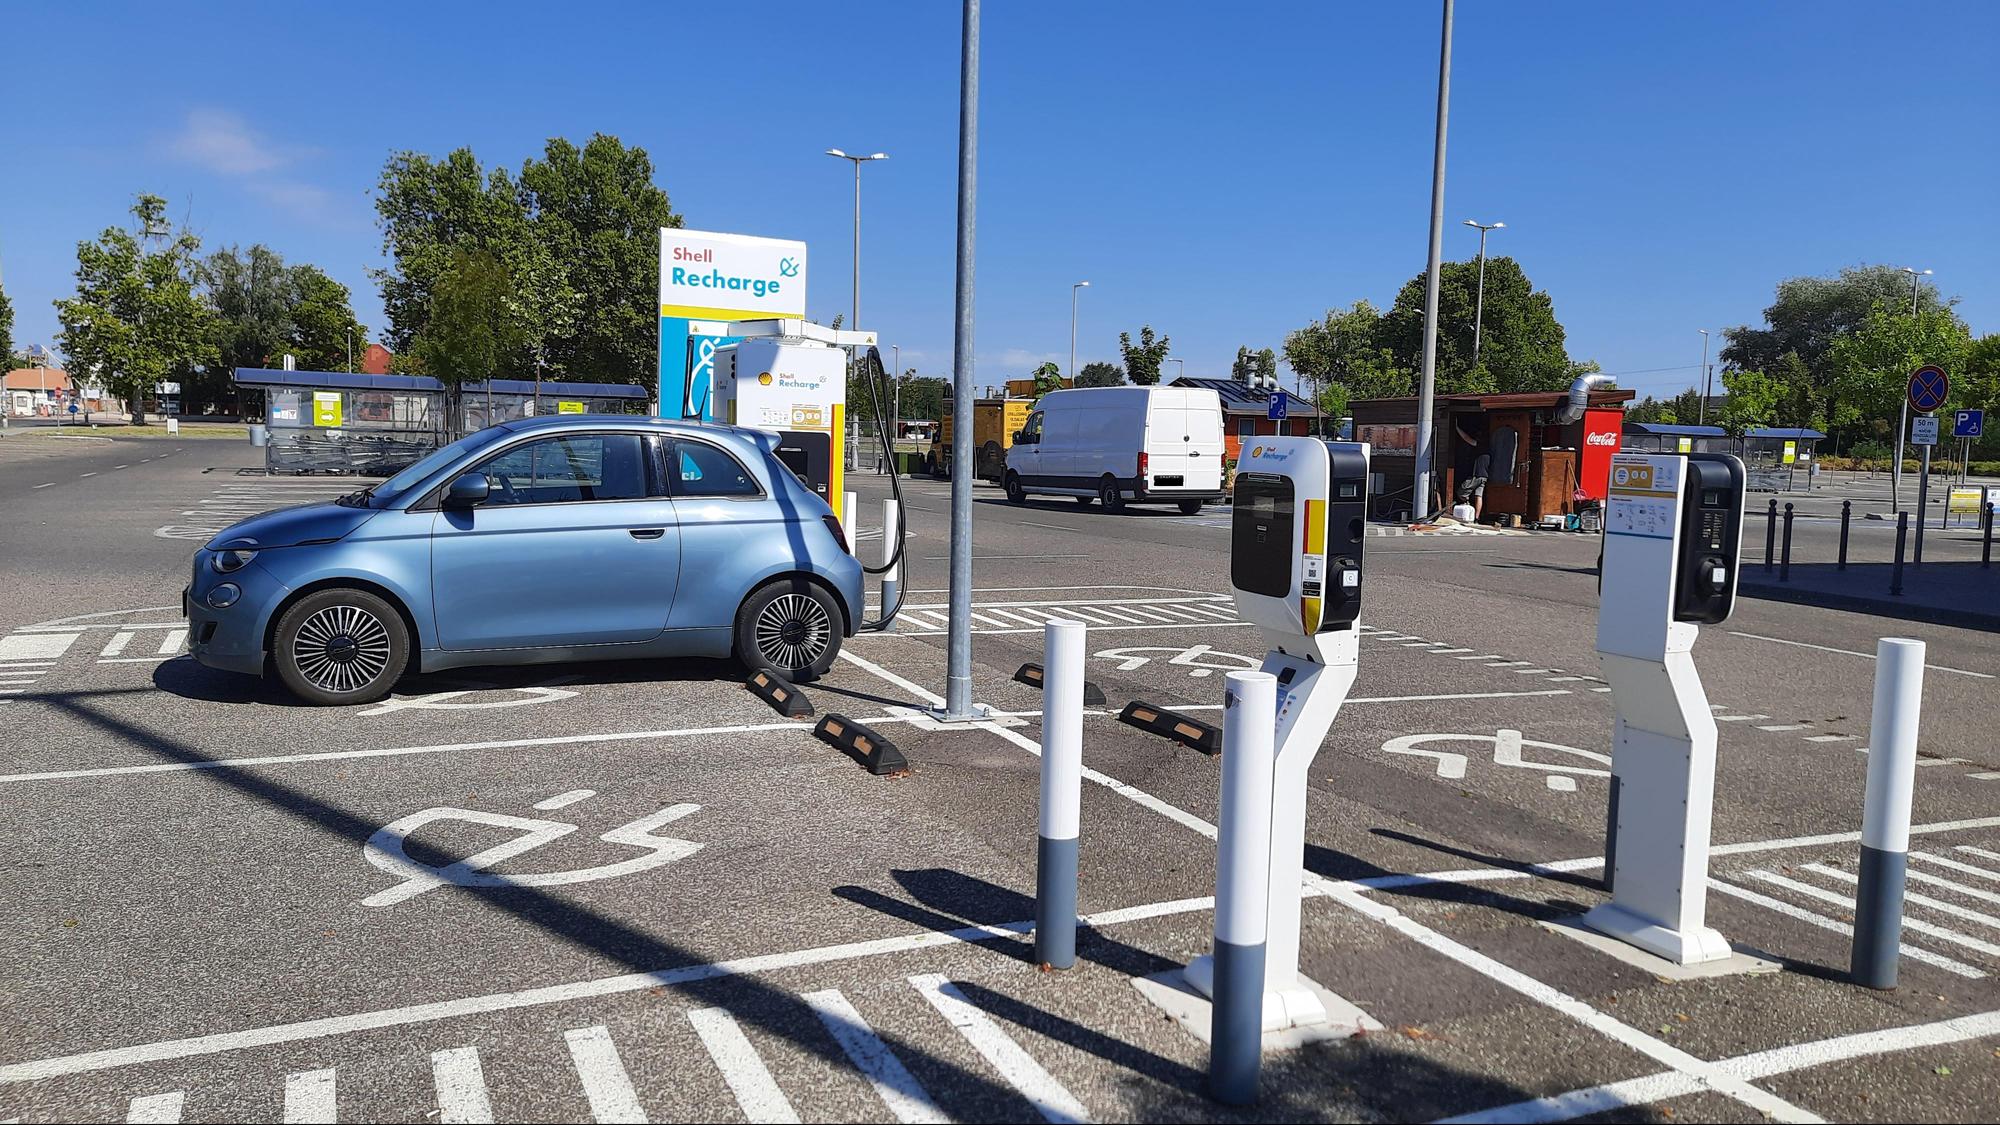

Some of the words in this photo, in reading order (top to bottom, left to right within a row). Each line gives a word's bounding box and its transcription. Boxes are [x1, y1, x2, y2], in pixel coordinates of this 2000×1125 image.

[673, 247, 712, 263] Shell
[672, 267, 780, 297] Recharge
[779, 379, 820, 390] Recharge
[1270, 395, 1279, 409] P
[1957, 413, 1969, 426] P
